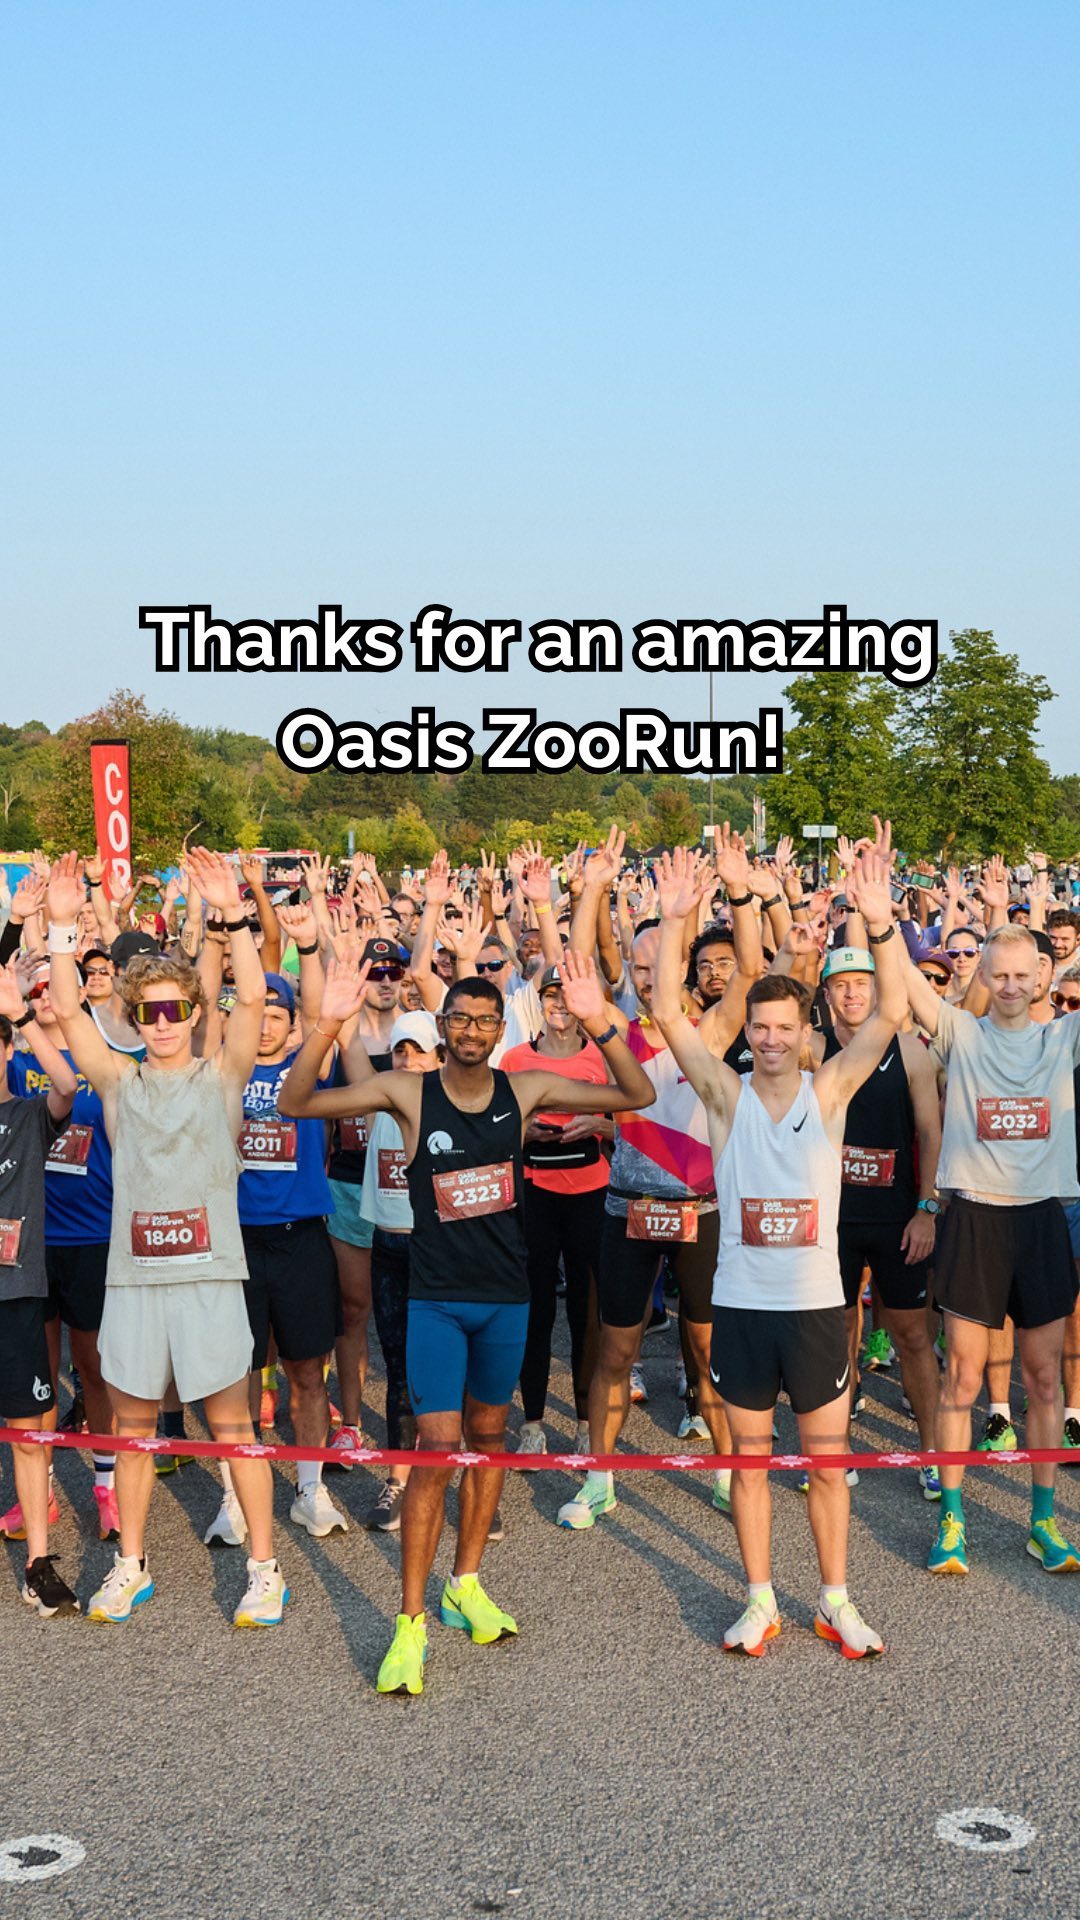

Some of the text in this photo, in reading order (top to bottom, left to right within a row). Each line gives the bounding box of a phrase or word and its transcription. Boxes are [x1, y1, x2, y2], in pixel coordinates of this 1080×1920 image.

[990, 1114, 1038, 1130] 2032
[243, 1136, 282, 1151] 2011
[843, 1160, 879, 1177] 1412
[452, 1183, 501, 1207] 2323
[645, 1216, 681, 1231] 1173
[760, 1217, 798, 1234] 637
[144, 1227, 193, 1246] 1840
